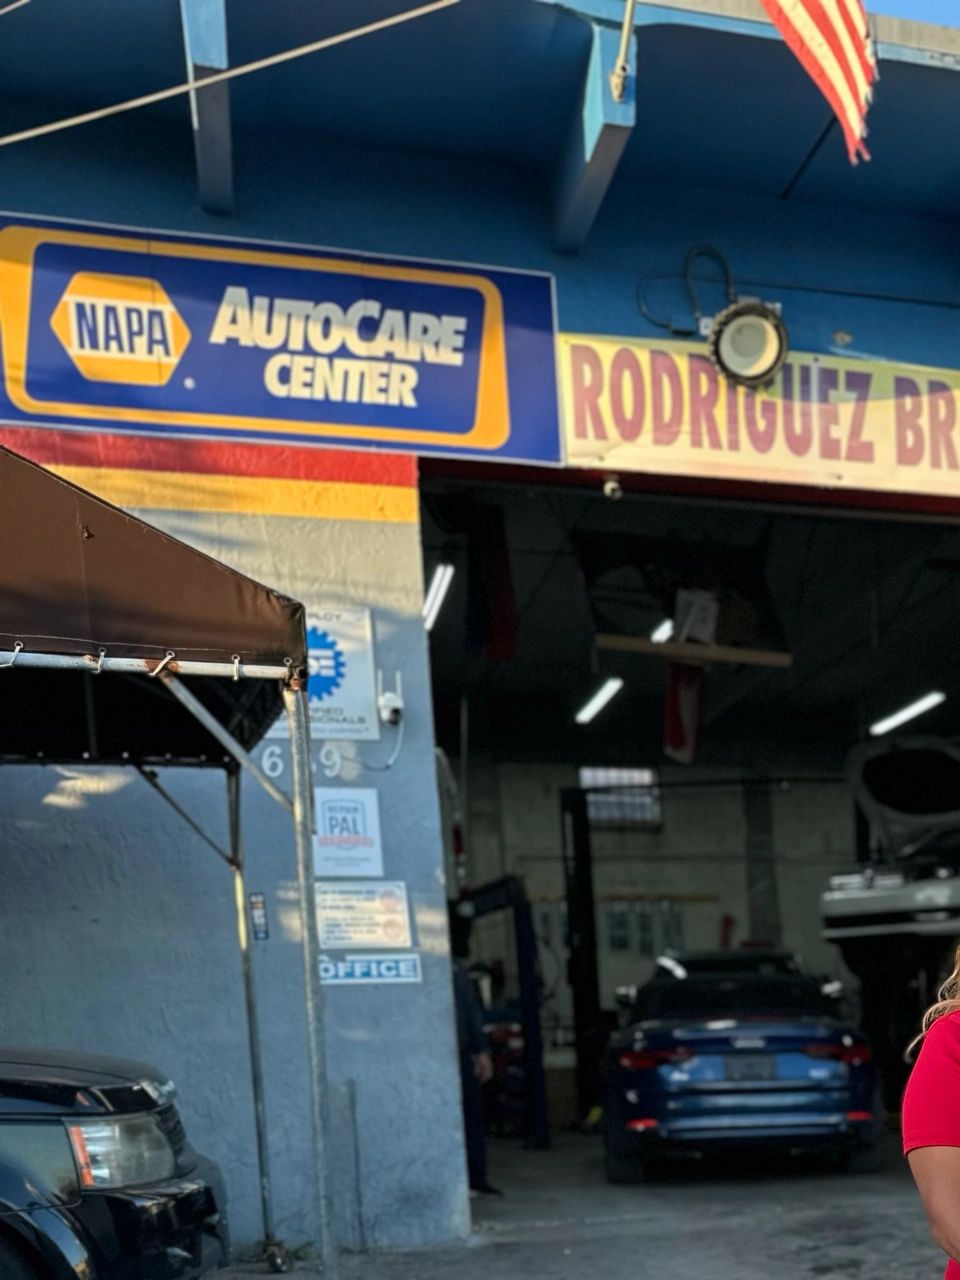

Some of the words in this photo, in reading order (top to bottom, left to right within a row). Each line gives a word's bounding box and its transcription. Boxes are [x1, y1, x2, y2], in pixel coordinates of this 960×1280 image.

[73, 301, 172, 357] NAPA
[264, 353, 418, 407] CENTER
[570, 344, 875, 463] RODRIGUEZ
[329, 816, 361, 835] PAL
[320, 961, 415, 977] OFFICE
